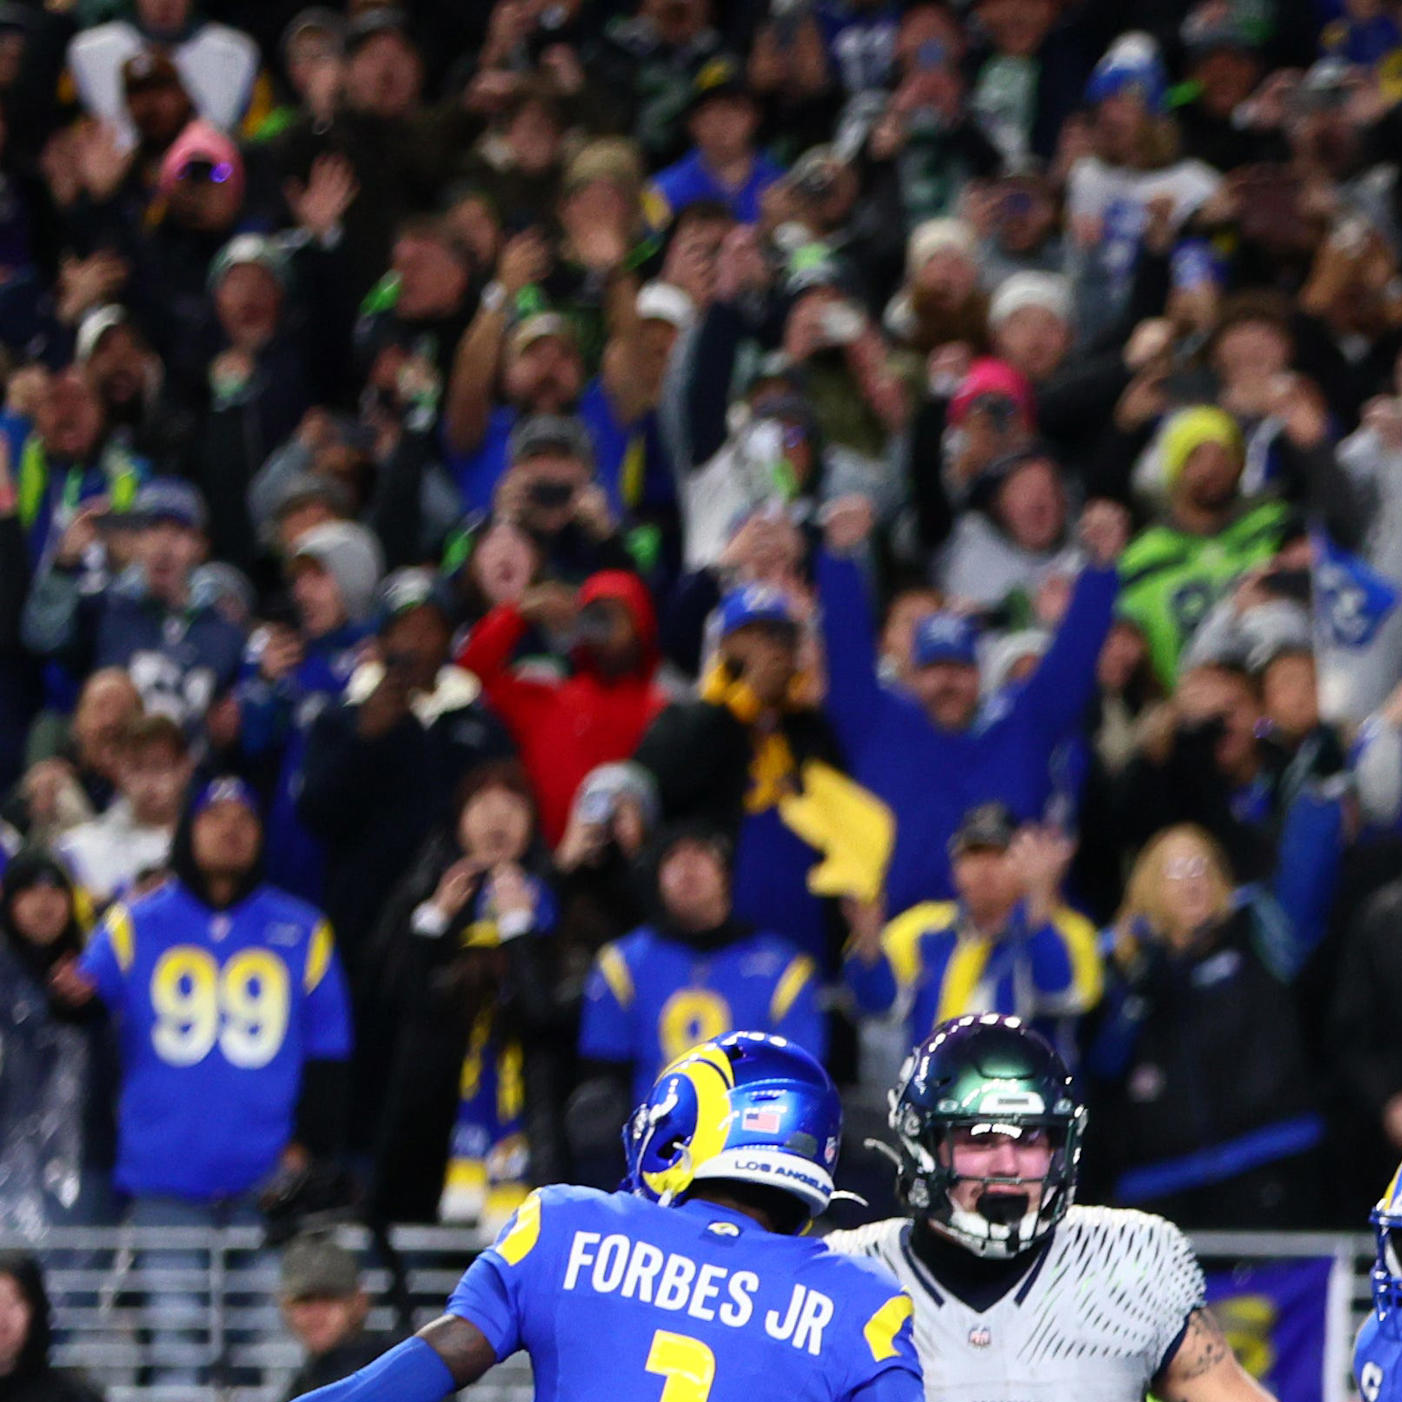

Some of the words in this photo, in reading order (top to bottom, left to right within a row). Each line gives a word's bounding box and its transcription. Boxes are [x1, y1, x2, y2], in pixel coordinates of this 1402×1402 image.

[150, 943, 292, 1070] 99
[734, 1159, 772, 1174] LOS
[562, 1230, 760, 1328] FORBES
[764, 1283, 835, 1356] JR
